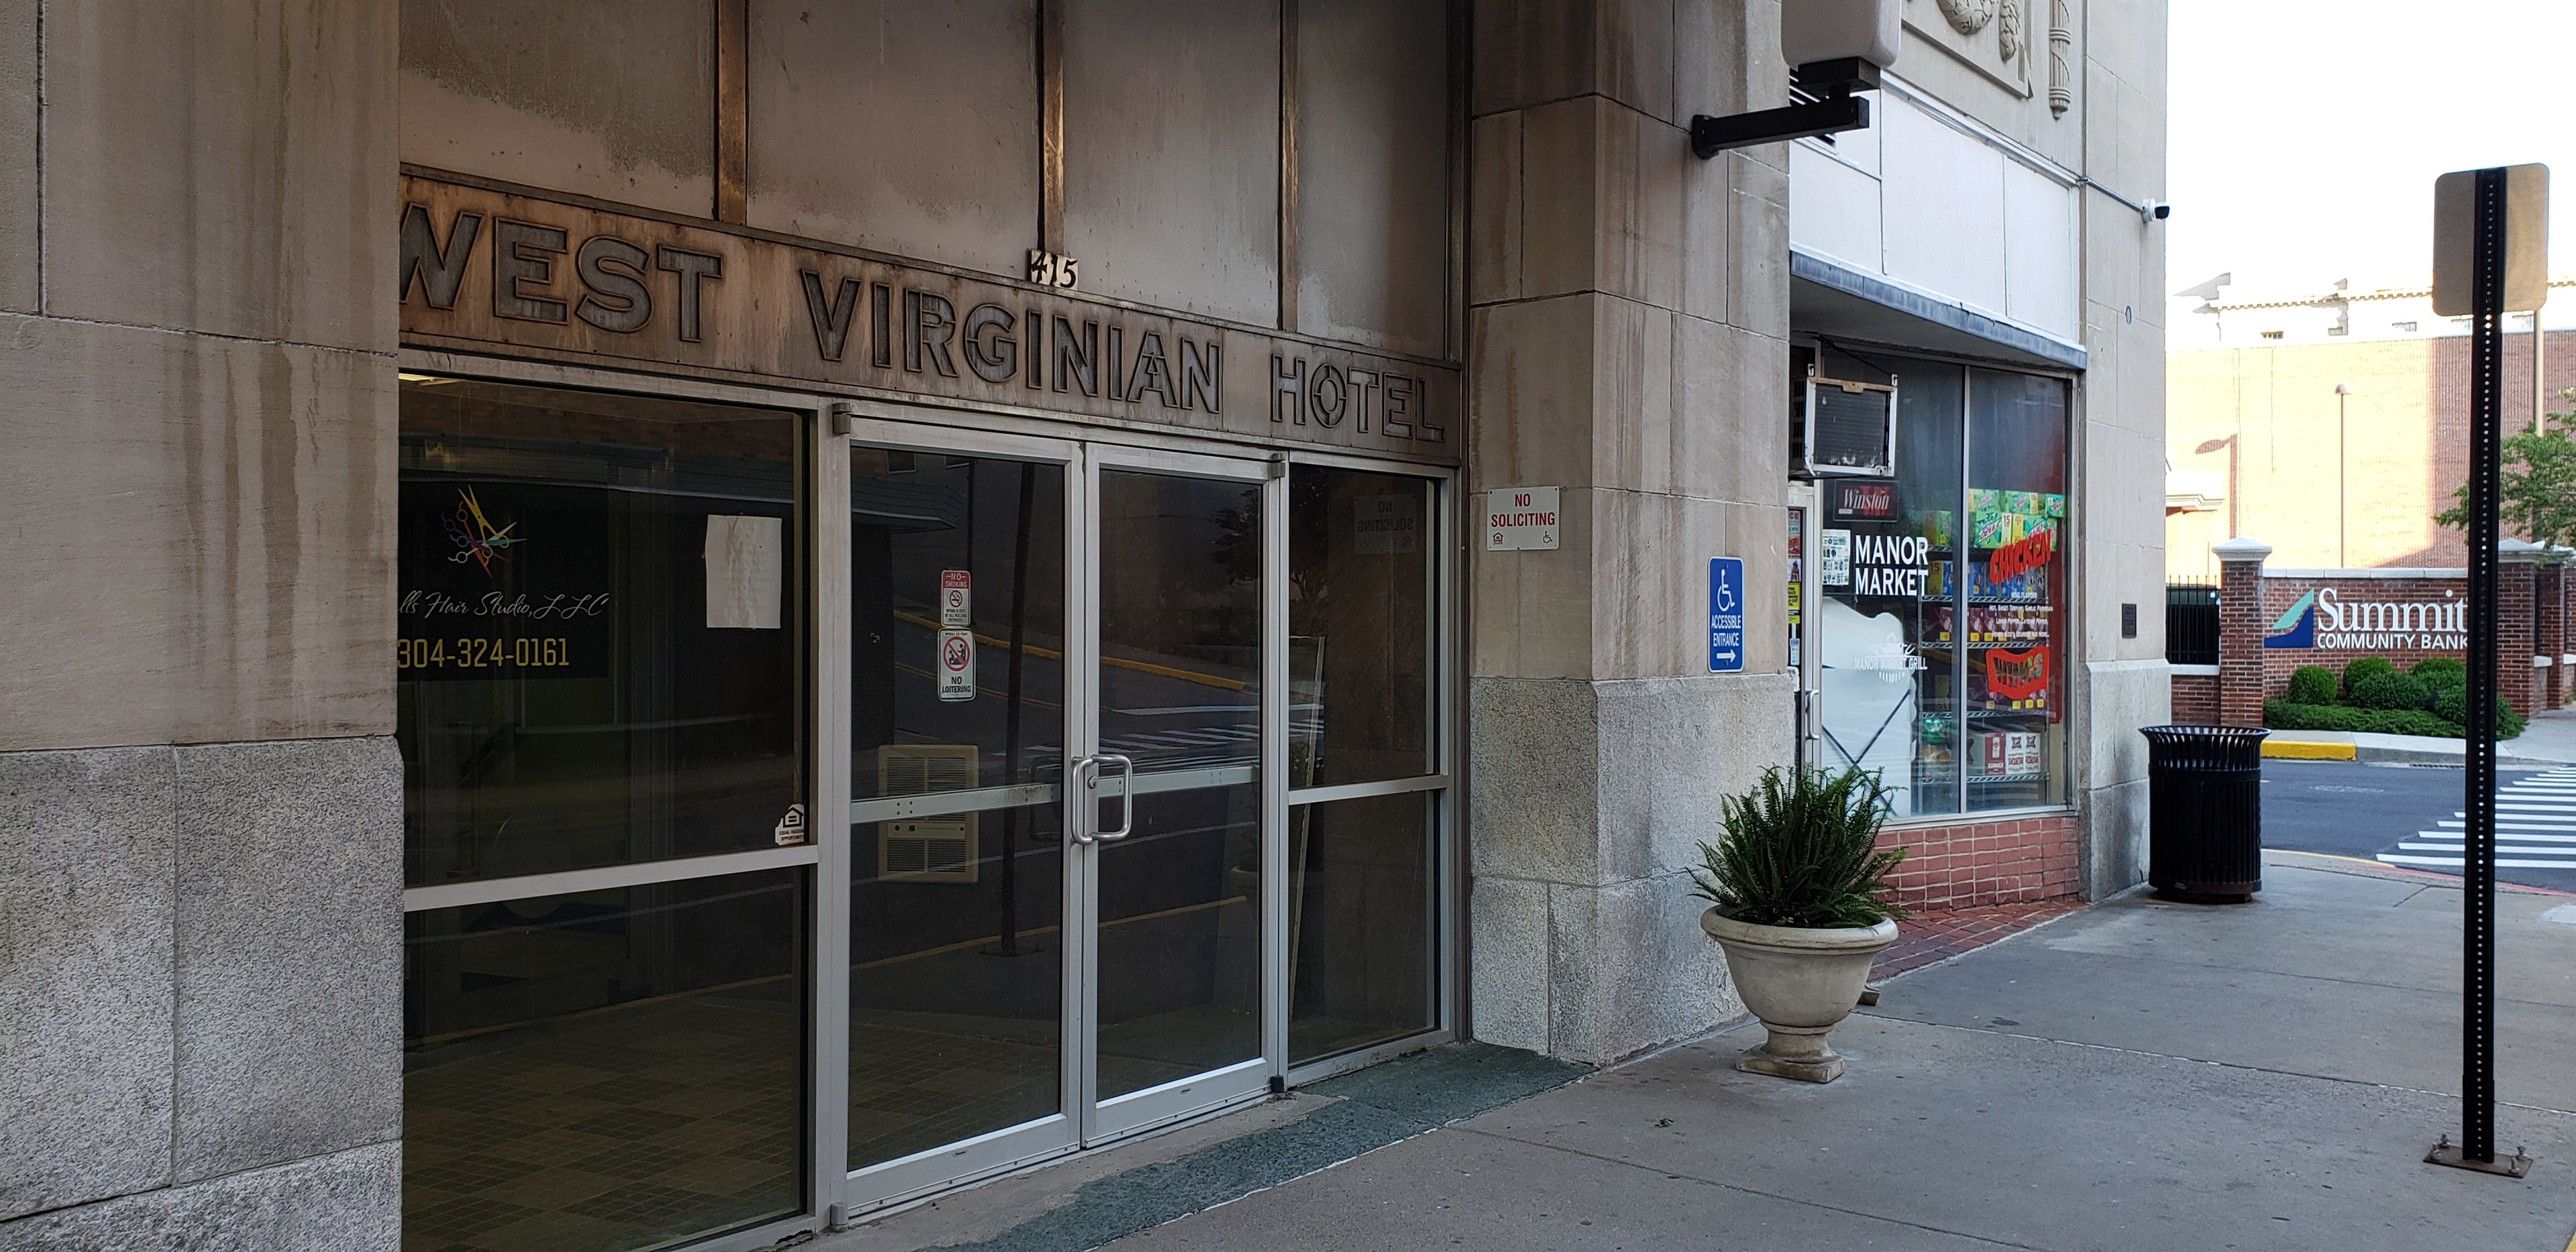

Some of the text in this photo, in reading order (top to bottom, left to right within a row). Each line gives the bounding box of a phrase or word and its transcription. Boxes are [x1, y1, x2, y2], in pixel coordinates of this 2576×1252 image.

[1030, 250, 1078, 288] 415
[399, 203, 1444, 443] WEST VIRGINIAN HOTEL
[1515, 494, 1531, 507] NO
[1844, 488, 1889, 510] Winston
[1491, 512, 1555, 527] SOLICITING
[2003, 515, 2010, 524] 15
[1855, 535, 1928, 565] MANOR
[1989, 526, 2051, 584] CHICKEN
[951, 573, 961, 581] NO
[1855, 568, 1928, 596] MARKET
[398, 590, 422, 614] lls
[425, 591, 470, 618] Hair
[2318, 587, 2468, 632] Summit
[1711, 615, 1741, 629] ACCESSIBLE
[1713, 632, 1739, 647] ENTRANCE
[2317, 632, 2468, 650] COMMUNITY BANK
[397, 638, 569, 668] 304-324-0161
[1855, 657, 1928, 670] MANOR MARKET GRILL
[951, 676, 962, 685] NO
